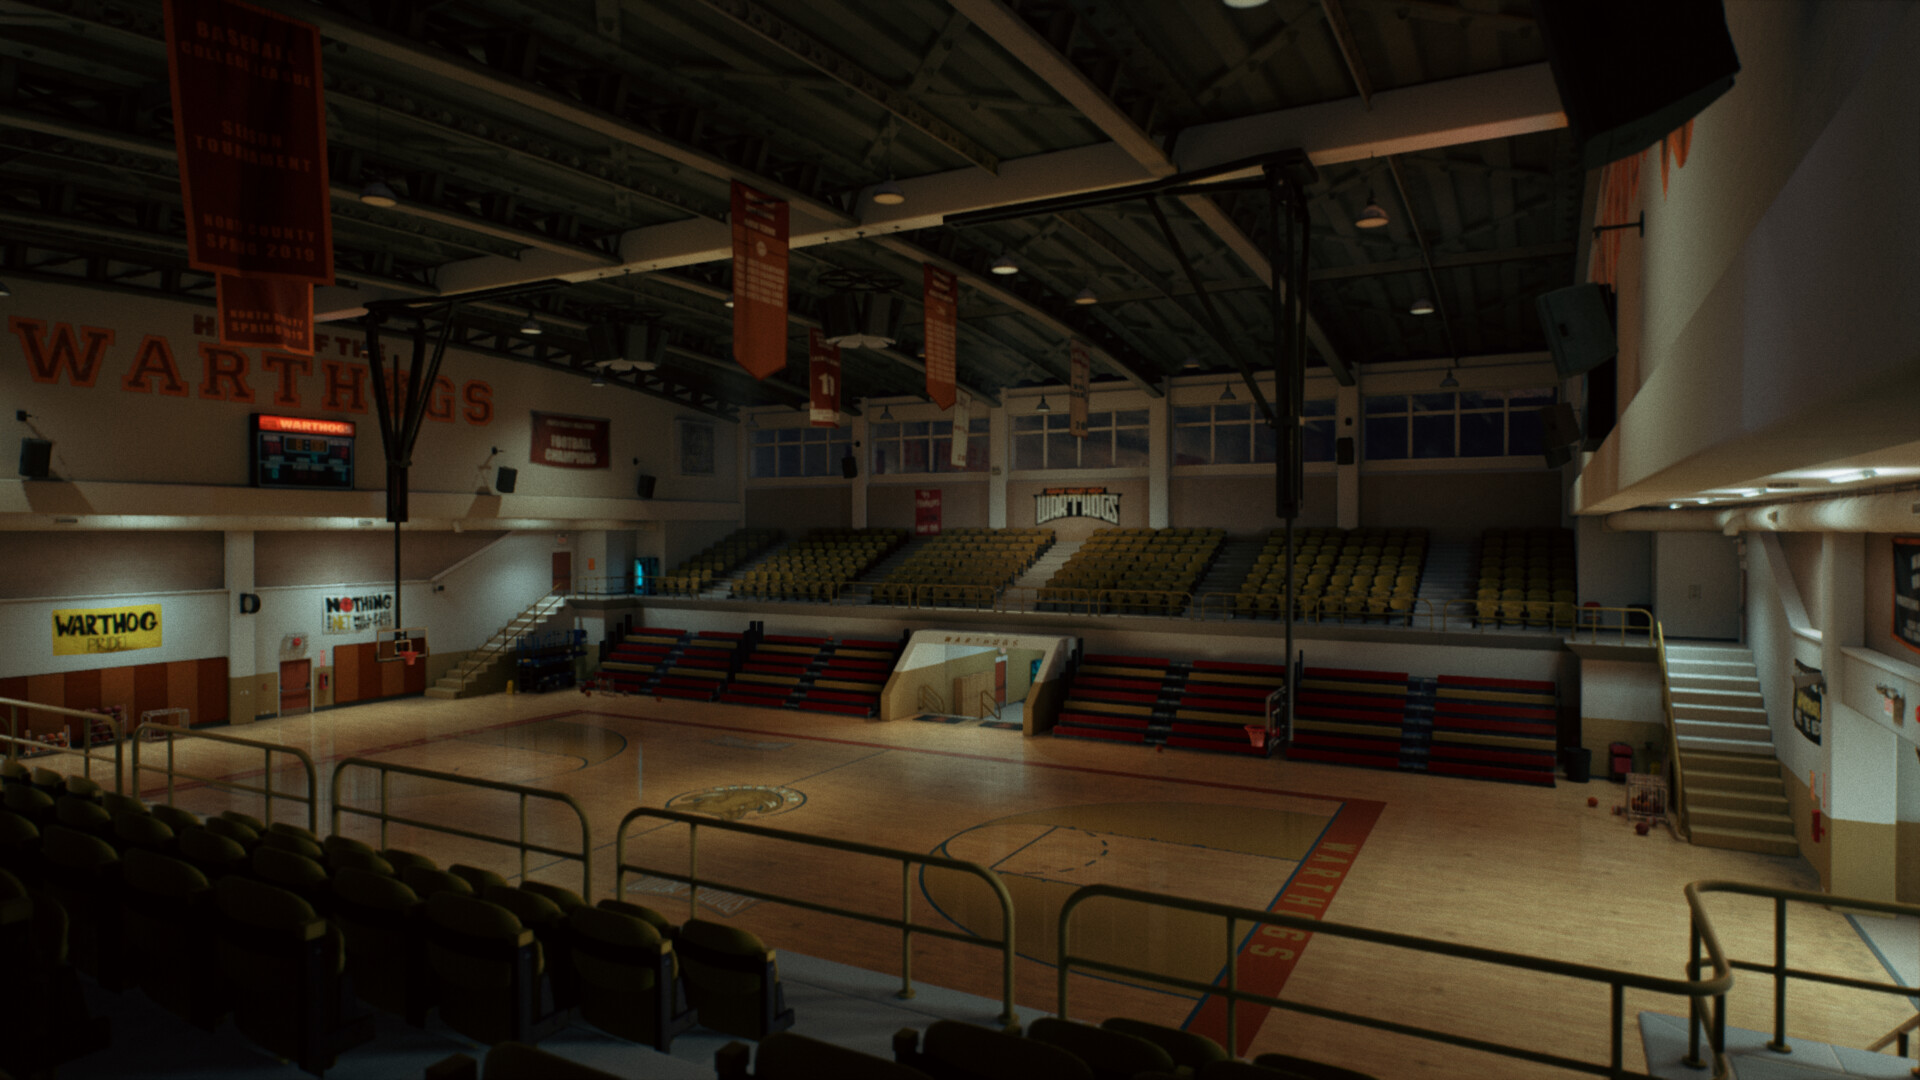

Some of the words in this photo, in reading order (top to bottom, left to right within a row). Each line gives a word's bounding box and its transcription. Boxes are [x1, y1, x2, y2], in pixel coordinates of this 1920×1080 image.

[248, 223, 315, 243] COUNTY
[266, 242, 315, 263] 2019
[230, 309, 270, 321] NORTH
[818, 371, 835, 397] 11
[279, 418, 353, 434] WARTHOGS
[1036, 494, 1119, 525] WARTHOGS
[239, 593, 261, 614] D
[325, 594, 392, 613] NOTHING
[55, 611, 158, 637] WARTHOG
